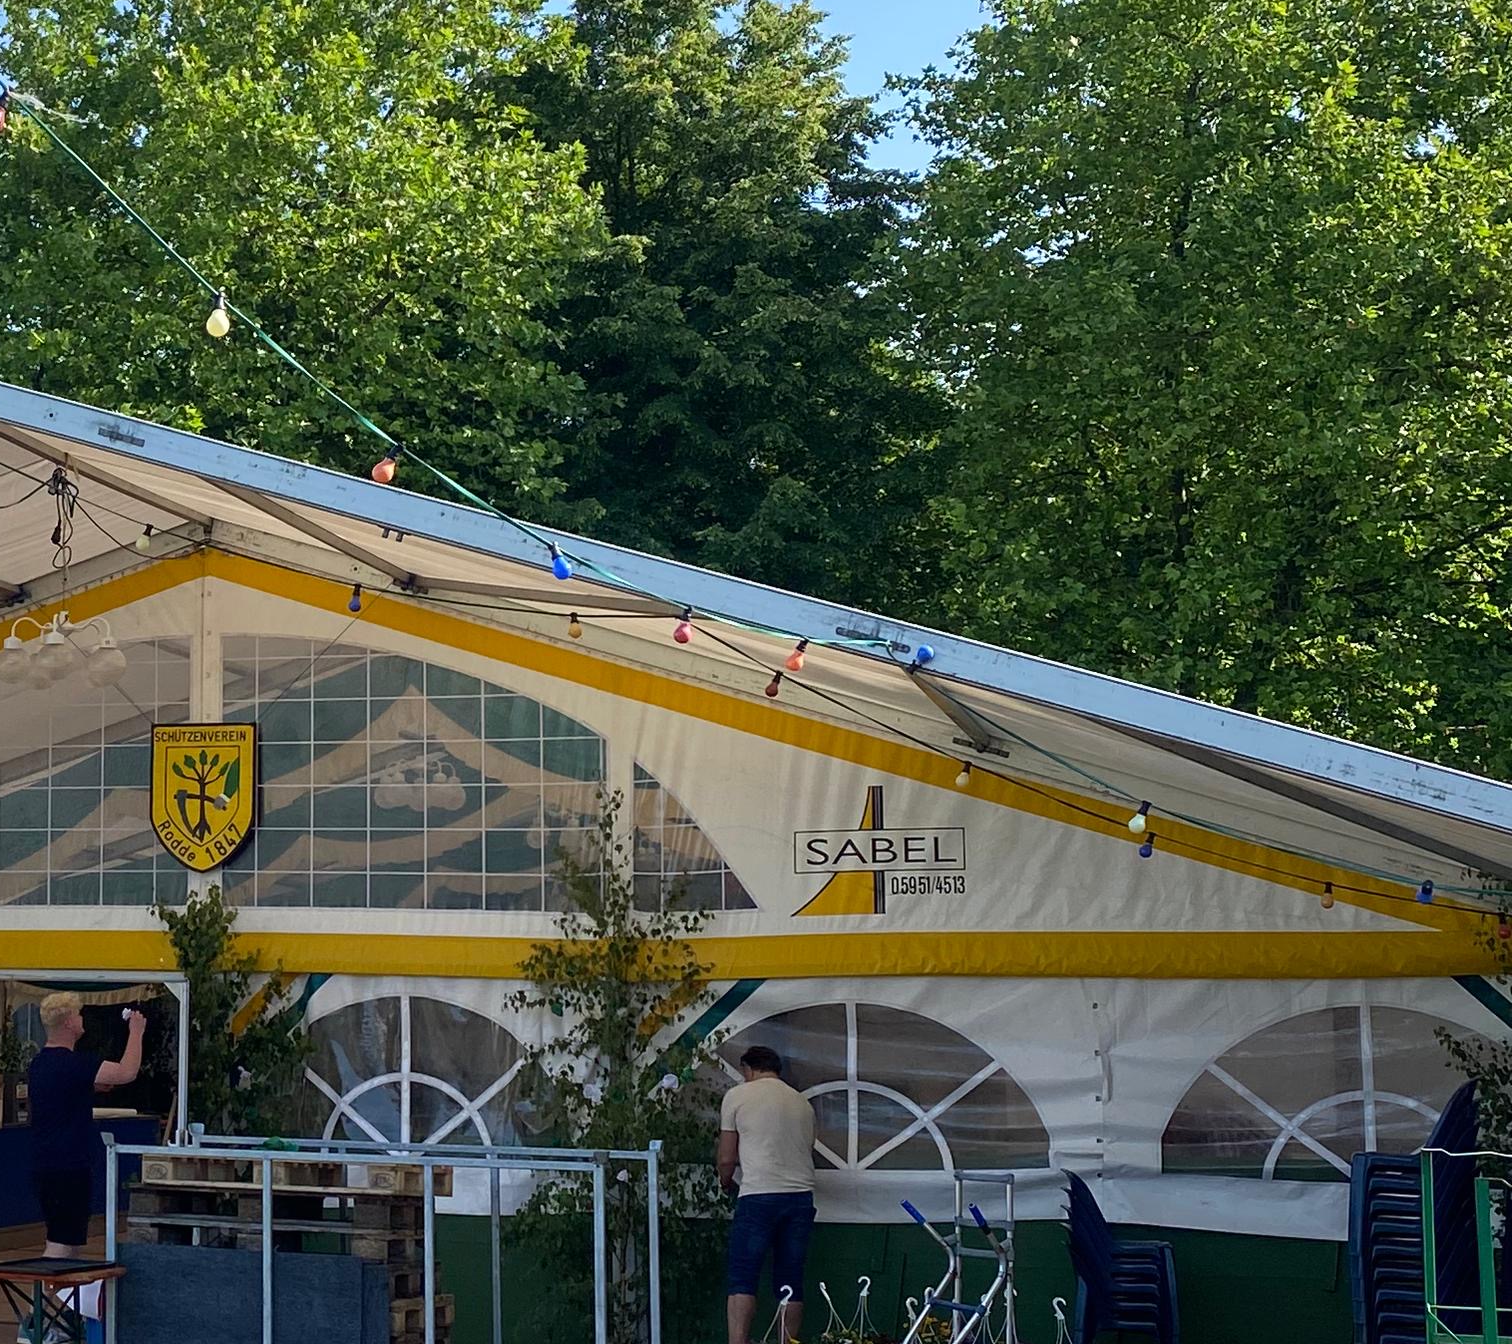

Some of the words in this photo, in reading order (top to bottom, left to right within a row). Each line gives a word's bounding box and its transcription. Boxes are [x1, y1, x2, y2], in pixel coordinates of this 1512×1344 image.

[155, 729, 247, 743] SCHÜTZENVEREIN
[157, 821, 197, 863] Rodde
[205, 823, 243, 864] 1847
[806, 836, 957, 865] SABEL
